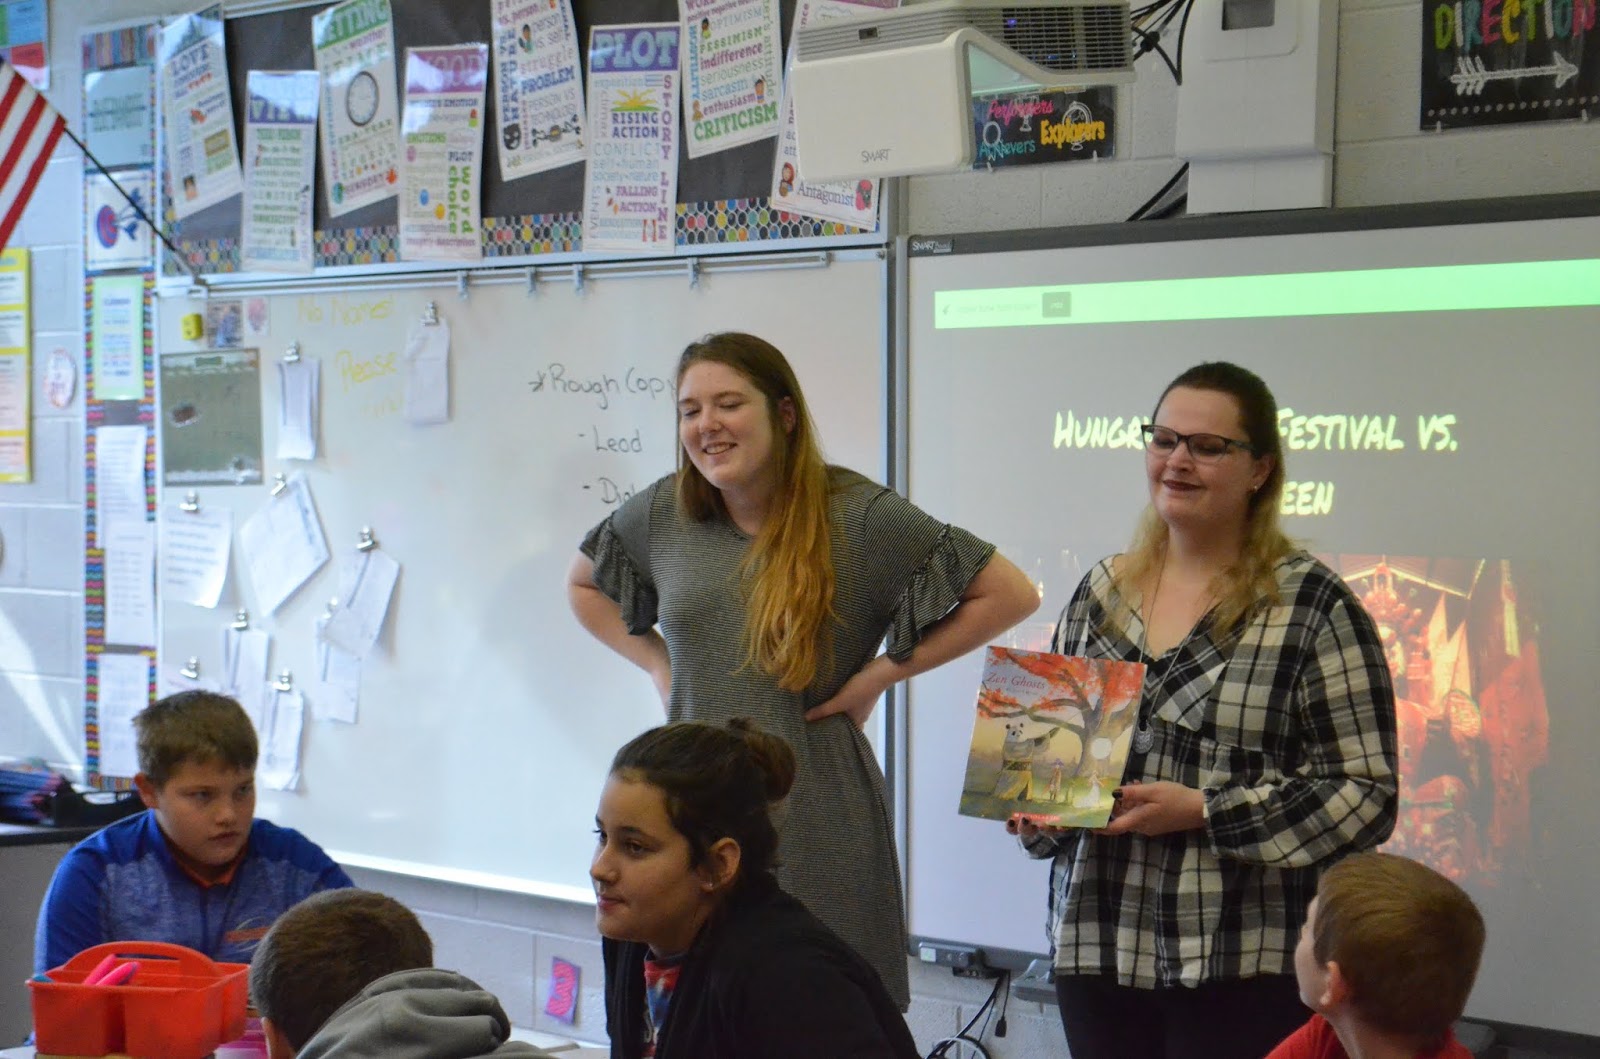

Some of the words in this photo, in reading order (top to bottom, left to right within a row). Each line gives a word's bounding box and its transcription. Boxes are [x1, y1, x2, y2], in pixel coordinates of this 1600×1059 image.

[1434, 0, 1597, 50] DIRECTION
[594, 30, 677, 70] PLOT
[701, 26, 763, 54] PESSIMISM
[520, 65, 576, 97] PROBLEM
[612, 112, 659, 124] RISING
[703, 92, 757, 116] enthusiasm
[612, 126, 659, 138] ACTION
[693, 100, 779, 141] CRITICISM
[1040, 117, 1106, 149] Explorers
[860, 148, 892, 163] SMART
[615, 185, 659, 197] FALLING
[797, 180, 855, 207] Antagonist
[619, 201, 658, 213] ACTION
[912, 240, 935, 251] SMART
[550, 362, 620, 410] Rough
[593, 424, 642, 453] Lead
[1277, 407, 1405, 450] FESTIVAL
[1418, 414, 1458, 451] VS.
[986, 671, 1008, 685] Zen
[1011, 675, 1047, 690] Ghosts
[547, 961, 575, 1016] 3
